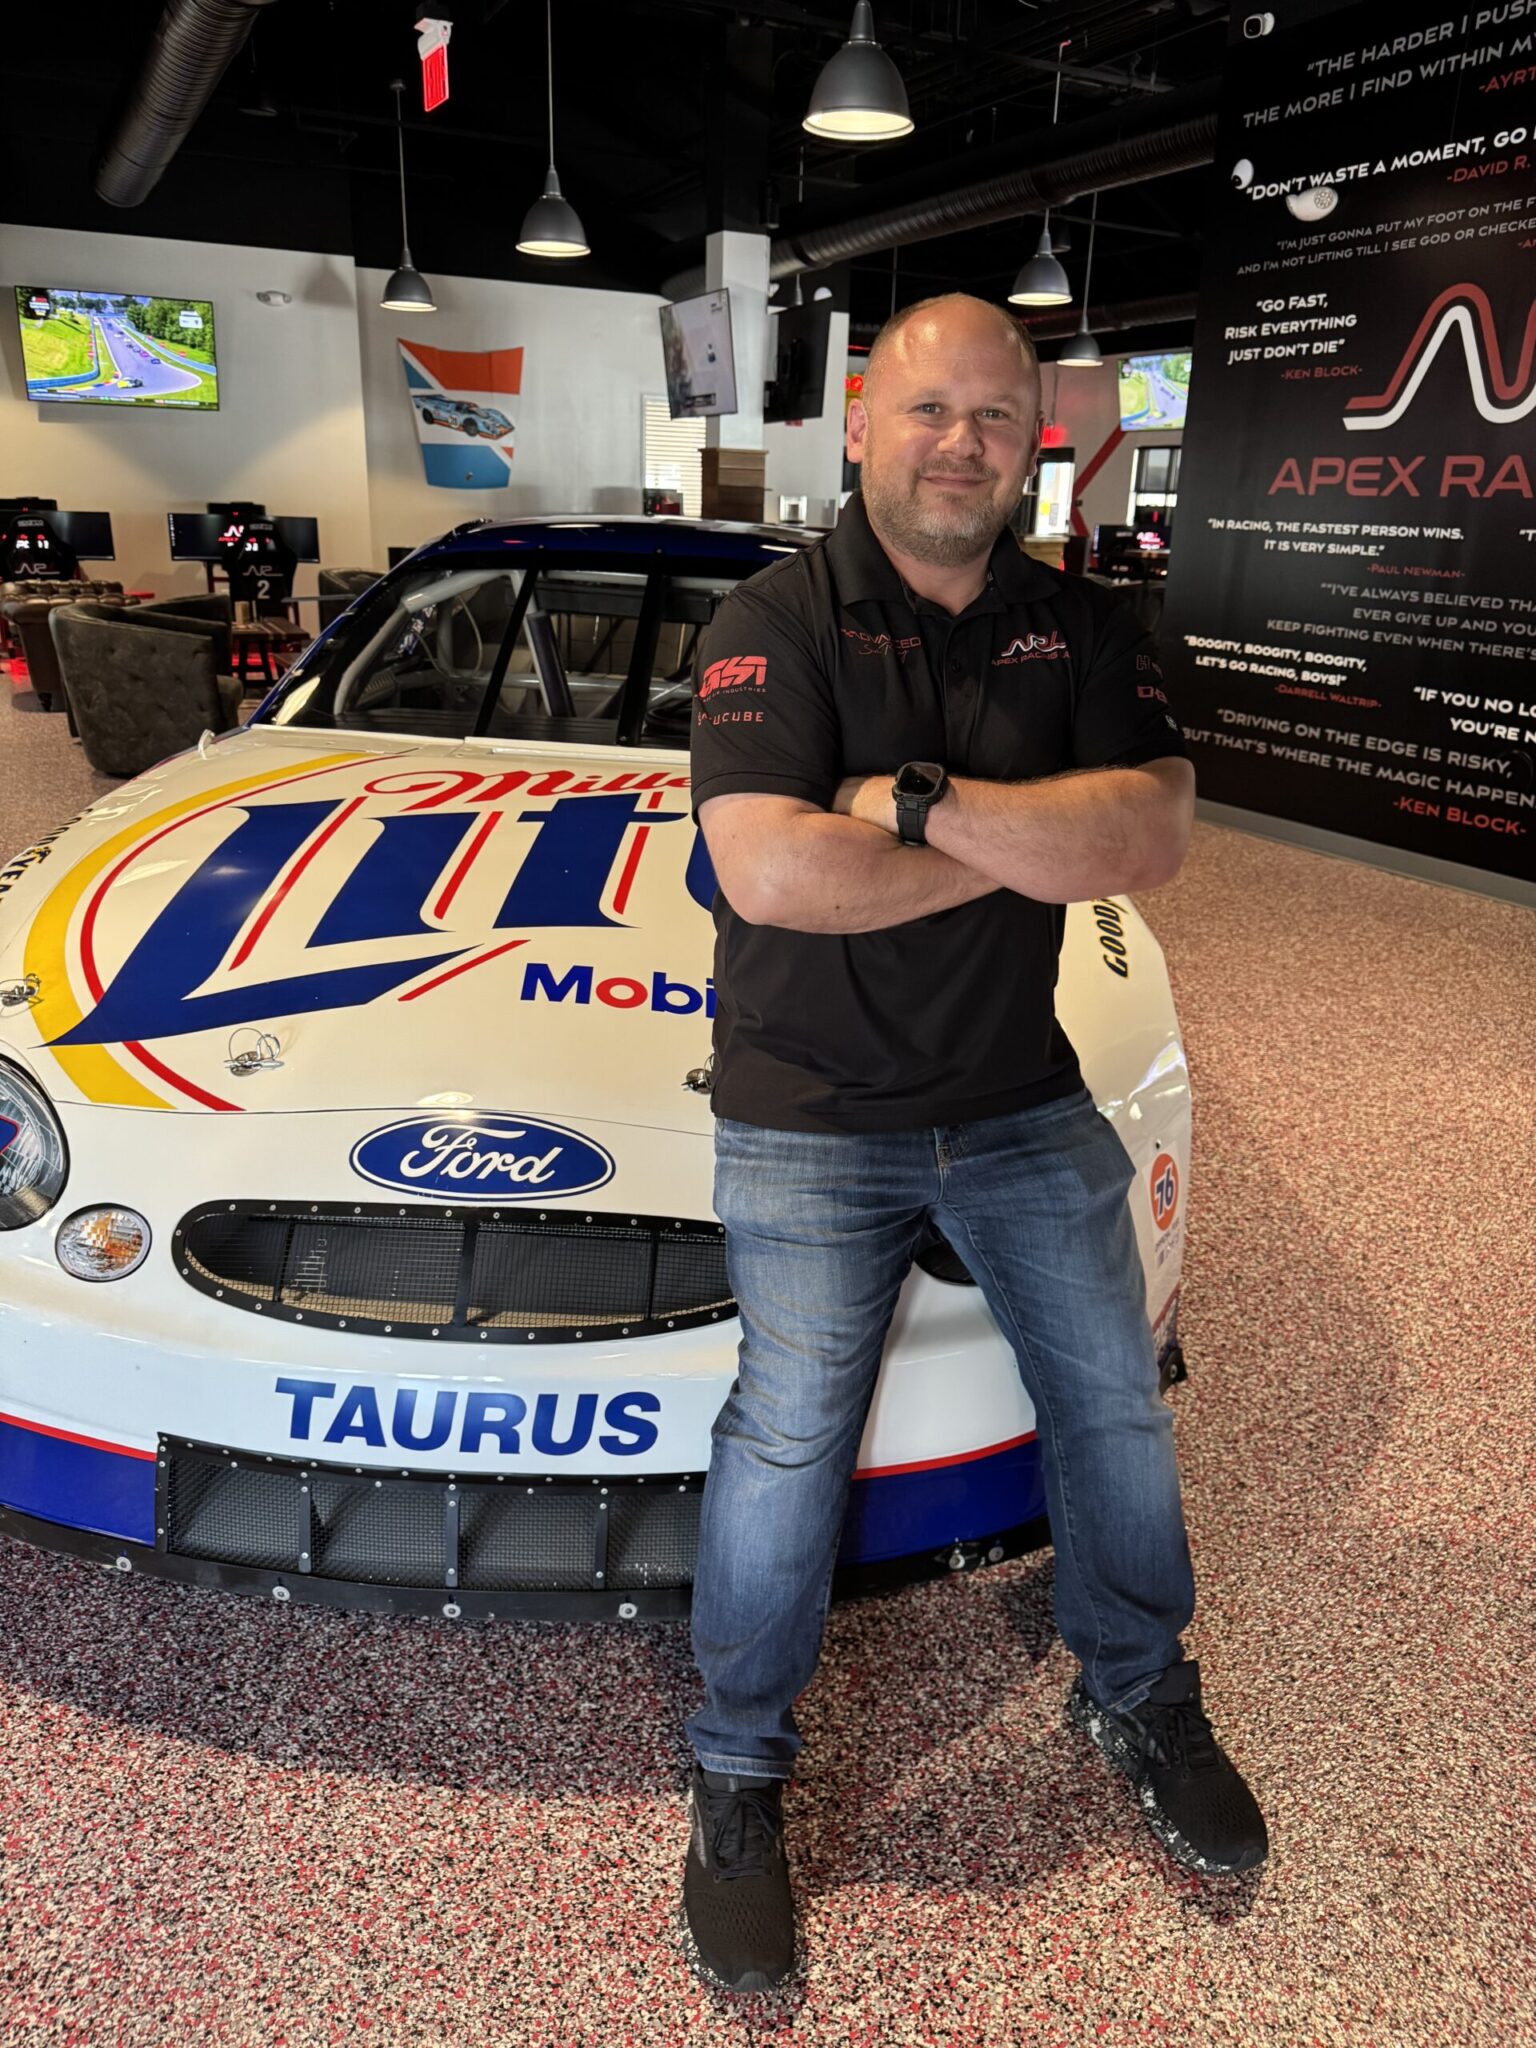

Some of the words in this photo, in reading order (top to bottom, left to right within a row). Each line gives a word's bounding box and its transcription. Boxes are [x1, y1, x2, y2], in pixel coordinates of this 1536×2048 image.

[1307, 52, 1356, 77] "THE
[1361, 22, 1454, 64] HARDER
[1461, 15, 1468, 34] I
[1243, 106, 1280, 128] THE
[1284, 88, 1344, 119] MORE
[1349, 83, 1355, 100] I
[1361, 69, 1412, 97] FIND
[1419, 42, 1504, 80] WITHIN
[1509, 32, 1536, 57] M
[1246, 176, 1306, 201] "DON'T
[1309, 162, 1370, 187] WASTE
[1372, 160, 1387, 176] A
[1390, 136, 1487, 172] MOMENT,
[1493, 127, 1527, 148] GO
[1446, 160, 1509, 183] -DAVID
[1513, 155, 1531, 170] R.
[1298, 233, 1327, 250] JUST
[1328, 226, 1373, 243] GONNA
[1375, 220, 1402, 236] PUT
[1404, 216, 1424, 230] MY
[1426, 210, 1466, 225] FOOT
[1468, 205, 1490, 218] ON
[1493, 199, 1522, 213] THE
[1525, 196, 1536, 208] F
[1236, 262, 1261, 275] AND
[1263, 260, 1279, 271] I'M
[1282, 255, 1305, 268] NOT
[1308, 248, 1354, 264] LIFTING
[1356, 243, 1381, 257] TILL
[1384, 241, 1389, 252] I
[1391, 238, 1416, 251] SEE
[1419, 232, 1450, 246] GOD
[1454, 228, 1475, 241] OR
[1256, 298, 1286, 313] "GO
[1289, 293, 1329, 310] FAST,
[1224, 324, 1258, 340] RISK
[1260, 314, 1358, 336] EVERYTHING
[1227, 348, 1261, 366] JUST
[1264, 342, 1309, 360] DON'T
[1312, 338, 1345, 355] DIE"
[1267, 456, 1426, 497] APEX
[1227, 519, 1272, 534] RACING,
[1275, 521, 1300, 533] THE
[1302, 523, 1359, 536] FASTEST
[1361, 525, 1419, 538] PERSON
[1422, 527, 1464, 540] WINS.
[1264, 539, 1276, 550] IT
[1278, 540, 1290, 552] IS
[1292, 541, 1325, 554] VERY
[257, 580, 270, 599] 2
[1360, 587, 1420, 603] ALWAYS
[1423, 592, 1504, 611] BELIEVED
[1267, 618, 1301, 632] KEEP
[1303, 623, 1370, 642] FIGHTING
[1373, 630, 1413, 647] EVEN
[1416, 635, 1465, 652] WHEN
[1353, 607, 1392, 622] EVER
[1395, 611, 1431, 628] GIVE
[1435, 614, 1458, 628] UP
[1460, 617, 1498, 633] AND
[1195, 655, 1227, 669] LET'S
[1228, 660, 1248, 672] GO
[1249, 662, 1298, 682] RACING,
[1301, 670, 1347, 687] BOYS!"
[1245, 643, 1302, 663] BOOGITY,
[1304, 649, 1368, 672] BOOGITY,
[1413, 686, 1438, 702] "IF
[1441, 691, 1480, 709] YOU
[1484, 698, 1513, 714] NO
[1217, 708, 1291, 734] "DRIVING
[1295, 723, 1321, 739] ON
[1324, 728, 1361, 747] THE
[1365, 735, 1418, 758] EDGE
[1423, 746, 1442, 763] IS
[1447, 750, 1513, 779] RISKY,
[1450, 717, 1519, 741] YOU'RE
[1214, 732, 1267, 755] THAT'S
[1270, 743, 1331, 769] WHERE
[1335, 756, 1372, 777] THE
[1376, 766, 1440, 791] MAGIC
[1446, 780, 1536, 809] HAPPEN
[1393, 796, 1441, 818] -KEN
[1446, 806, 1527, 837] BLOCK-
[28, 792, 716, 1049] Lit
[400, 1124, 563, 1184] Ford
[1155, 1163, 1175, 1220] 76
[275, 1377, 661, 1456] TAURUS
